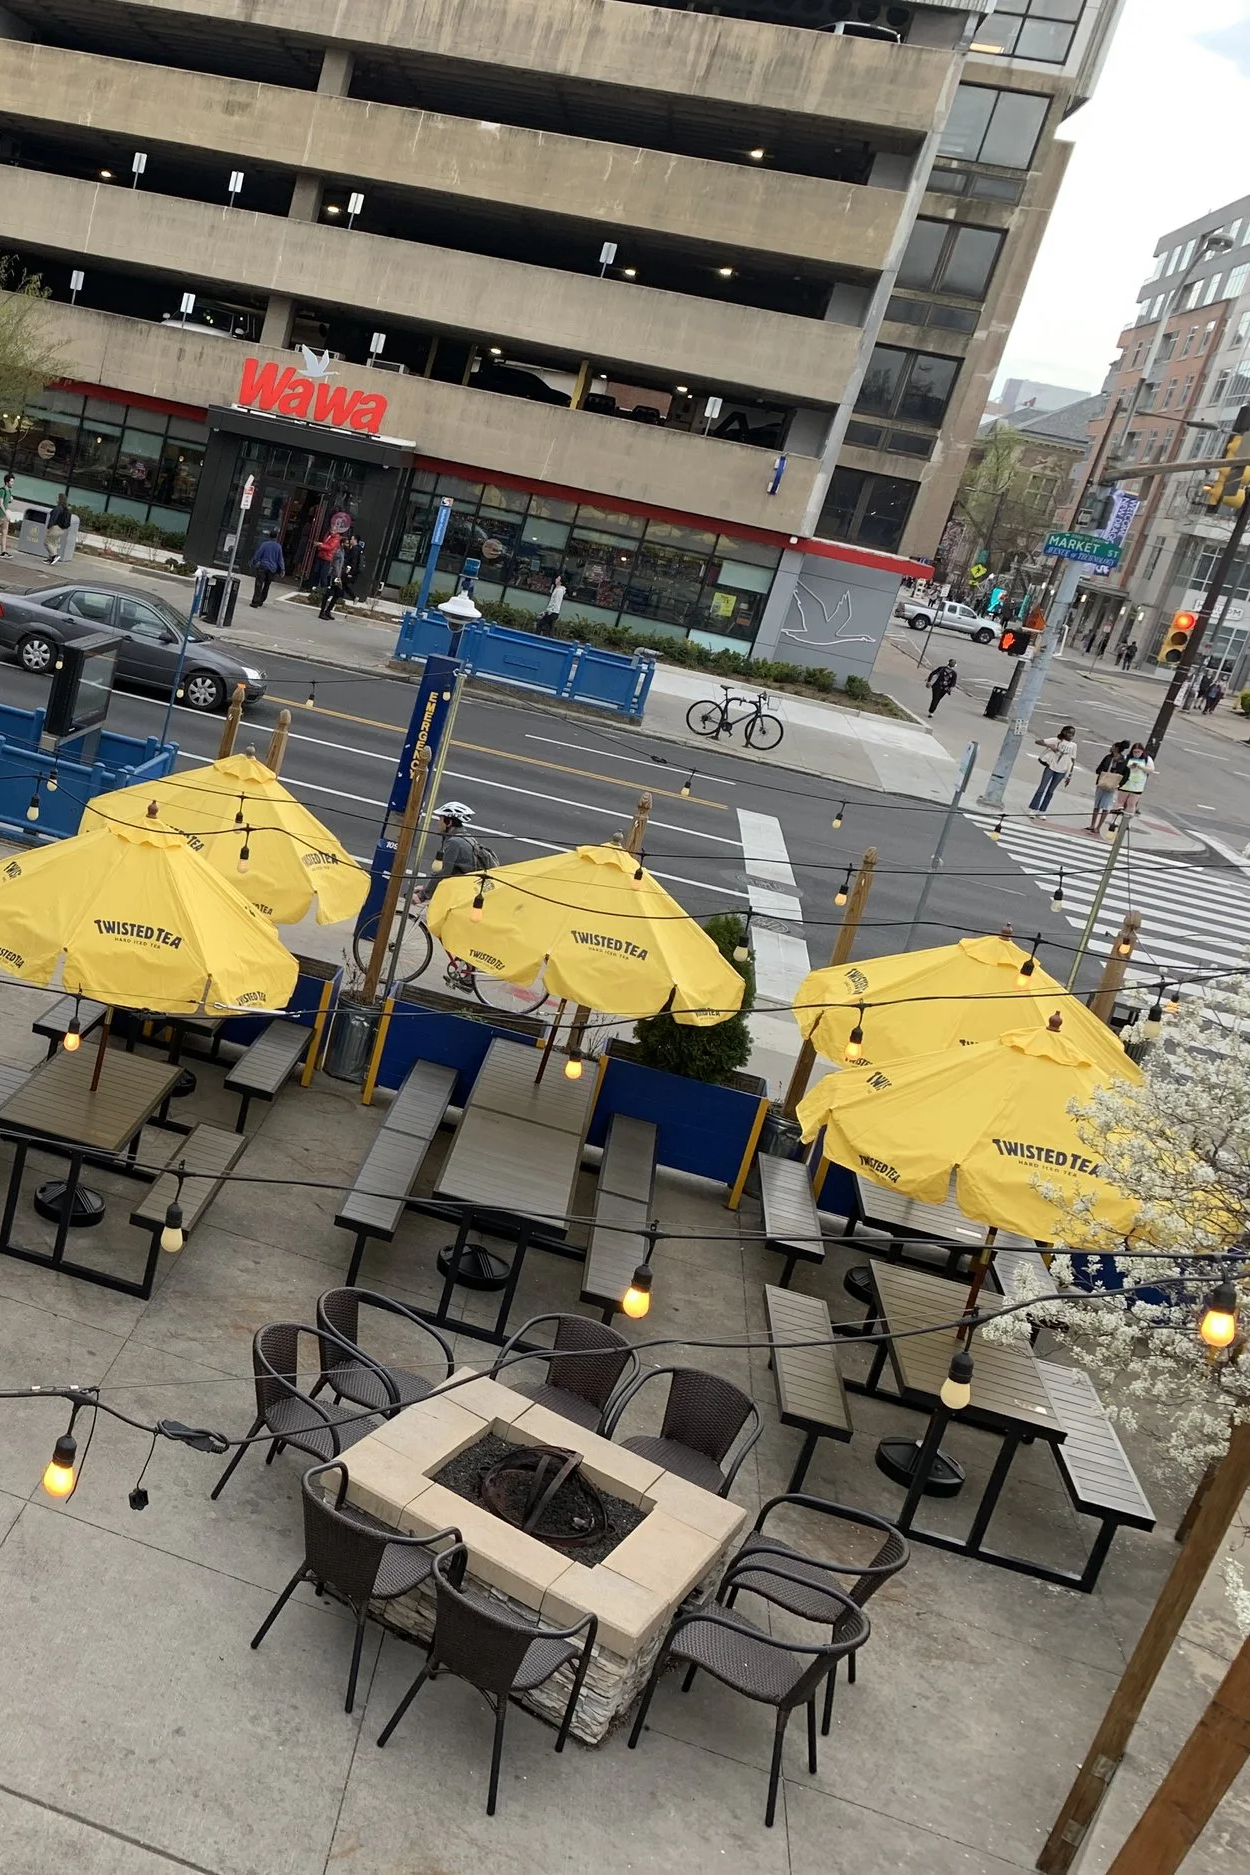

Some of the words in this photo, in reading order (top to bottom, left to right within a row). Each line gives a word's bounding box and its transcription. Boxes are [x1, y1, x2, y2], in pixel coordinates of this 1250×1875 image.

[238, 357, 388, 434] Wawa
[1048, 535, 1101, 554] MARKET
[1107, 549, 1120, 558] ST
[186, 835, 205, 852] TEA
[93, 919, 154, 940] TWISTED
[155, 927, 182, 949] TEA
[570, 930, 623, 951] TWISTED
[624, 941, 648, 961] TEA
[469, 949, 496, 967] TWISTED
[859, 1154, 888, 1173] TWISTED
[885, 1166, 901, 1183] TEA
[992, 1138, 1068, 1166] TWISTED
[1070, 1153, 1100, 1178] TEA
